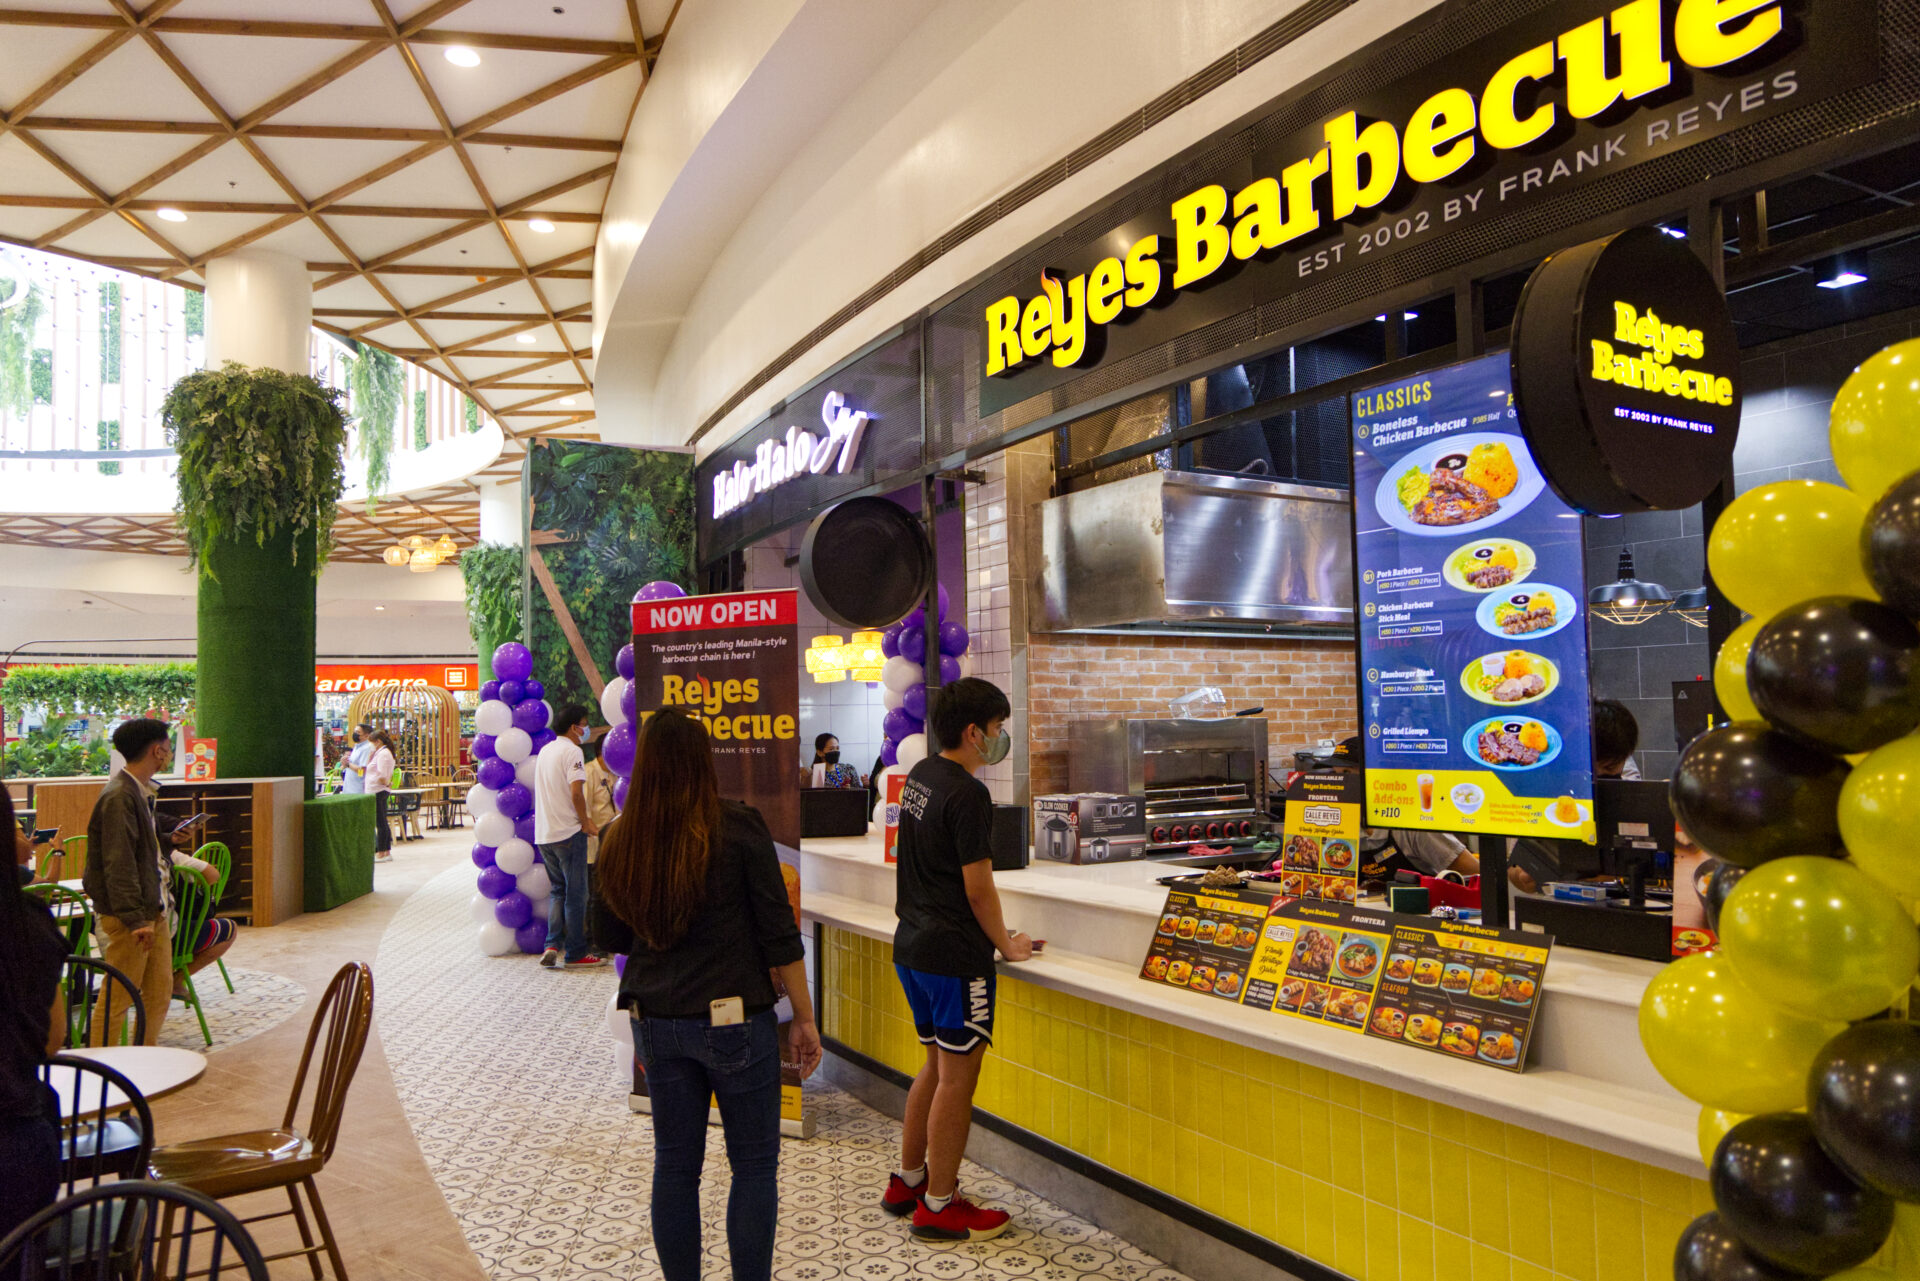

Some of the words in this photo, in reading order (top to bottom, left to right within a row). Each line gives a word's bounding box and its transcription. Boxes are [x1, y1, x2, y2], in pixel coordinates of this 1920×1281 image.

[1299, 243, 1346, 277] EST
[1358, 211, 1430, 254] 2002
[1444, 188, 1484, 222] BY
[1500, 134, 1627, 201] FRANK
[1647, 70, 1798, 146] REYES
[986, 234, 1161, 377] Reyes
[1172, 0, 1782, 289] Barbecue
[1614, 300, 1704, 364] Reyes
[1591, 339, 1733, 406] Barbecue
[1357, 381, 1432, 418] CLASSICS
[1372, 415, 1418, 435] Boneless
[1614, 407, 1629, 418] EST
[1631, 411, 1650, 422] 2002
[1651, 414, 1662, 425] BY
[1663, 417, 1687, 429] FRANK
[1689, 422, 1713, 433] REYES
[1373, 430, 1415, 447] Chicken
[1415, 417, 1468, 437] Barbecue
[1393, 567, 1424, 577] Barbecue
[650, 604, 704, 628] NOW
[711, 599, 777, 624] OPEN
[1404, 601, 1434, 610] Barbecue
[651, 645, 665, 653] The
[667, 642, 703, 652] country's
[704, 640, 734, 651] leading
[736, 636, 787, 648] Manila-style
[662, 654, 698, 663] barbecue
[700, 652, 721, 661] chain
[723, 651, 730, 660] is
[731, 651, 751, 660] here
[1381, 670, 1416, 679] Hamburger
[314, 675, 428, 692] ardware
[662, 672, 759, 715] Reyes
[1383, 727, 1404, 735] Grilled
[1373, 780, 1407, 791] Combo
[1373, 793, 1415, 805] Add-ons
[1305, 811, 1321, 819] CALLE
[1352, 915, 1386, 926] FRONTERA
[1440, 921, 1462, 932] Reyes
[1463, 925, 1499, 937] Barbecue
[1396, 930, 1425, 942] CLASSICS
[1381, 982, 1409, 995] SEAFOOD
[969, 977, 990, 1022] MAN
